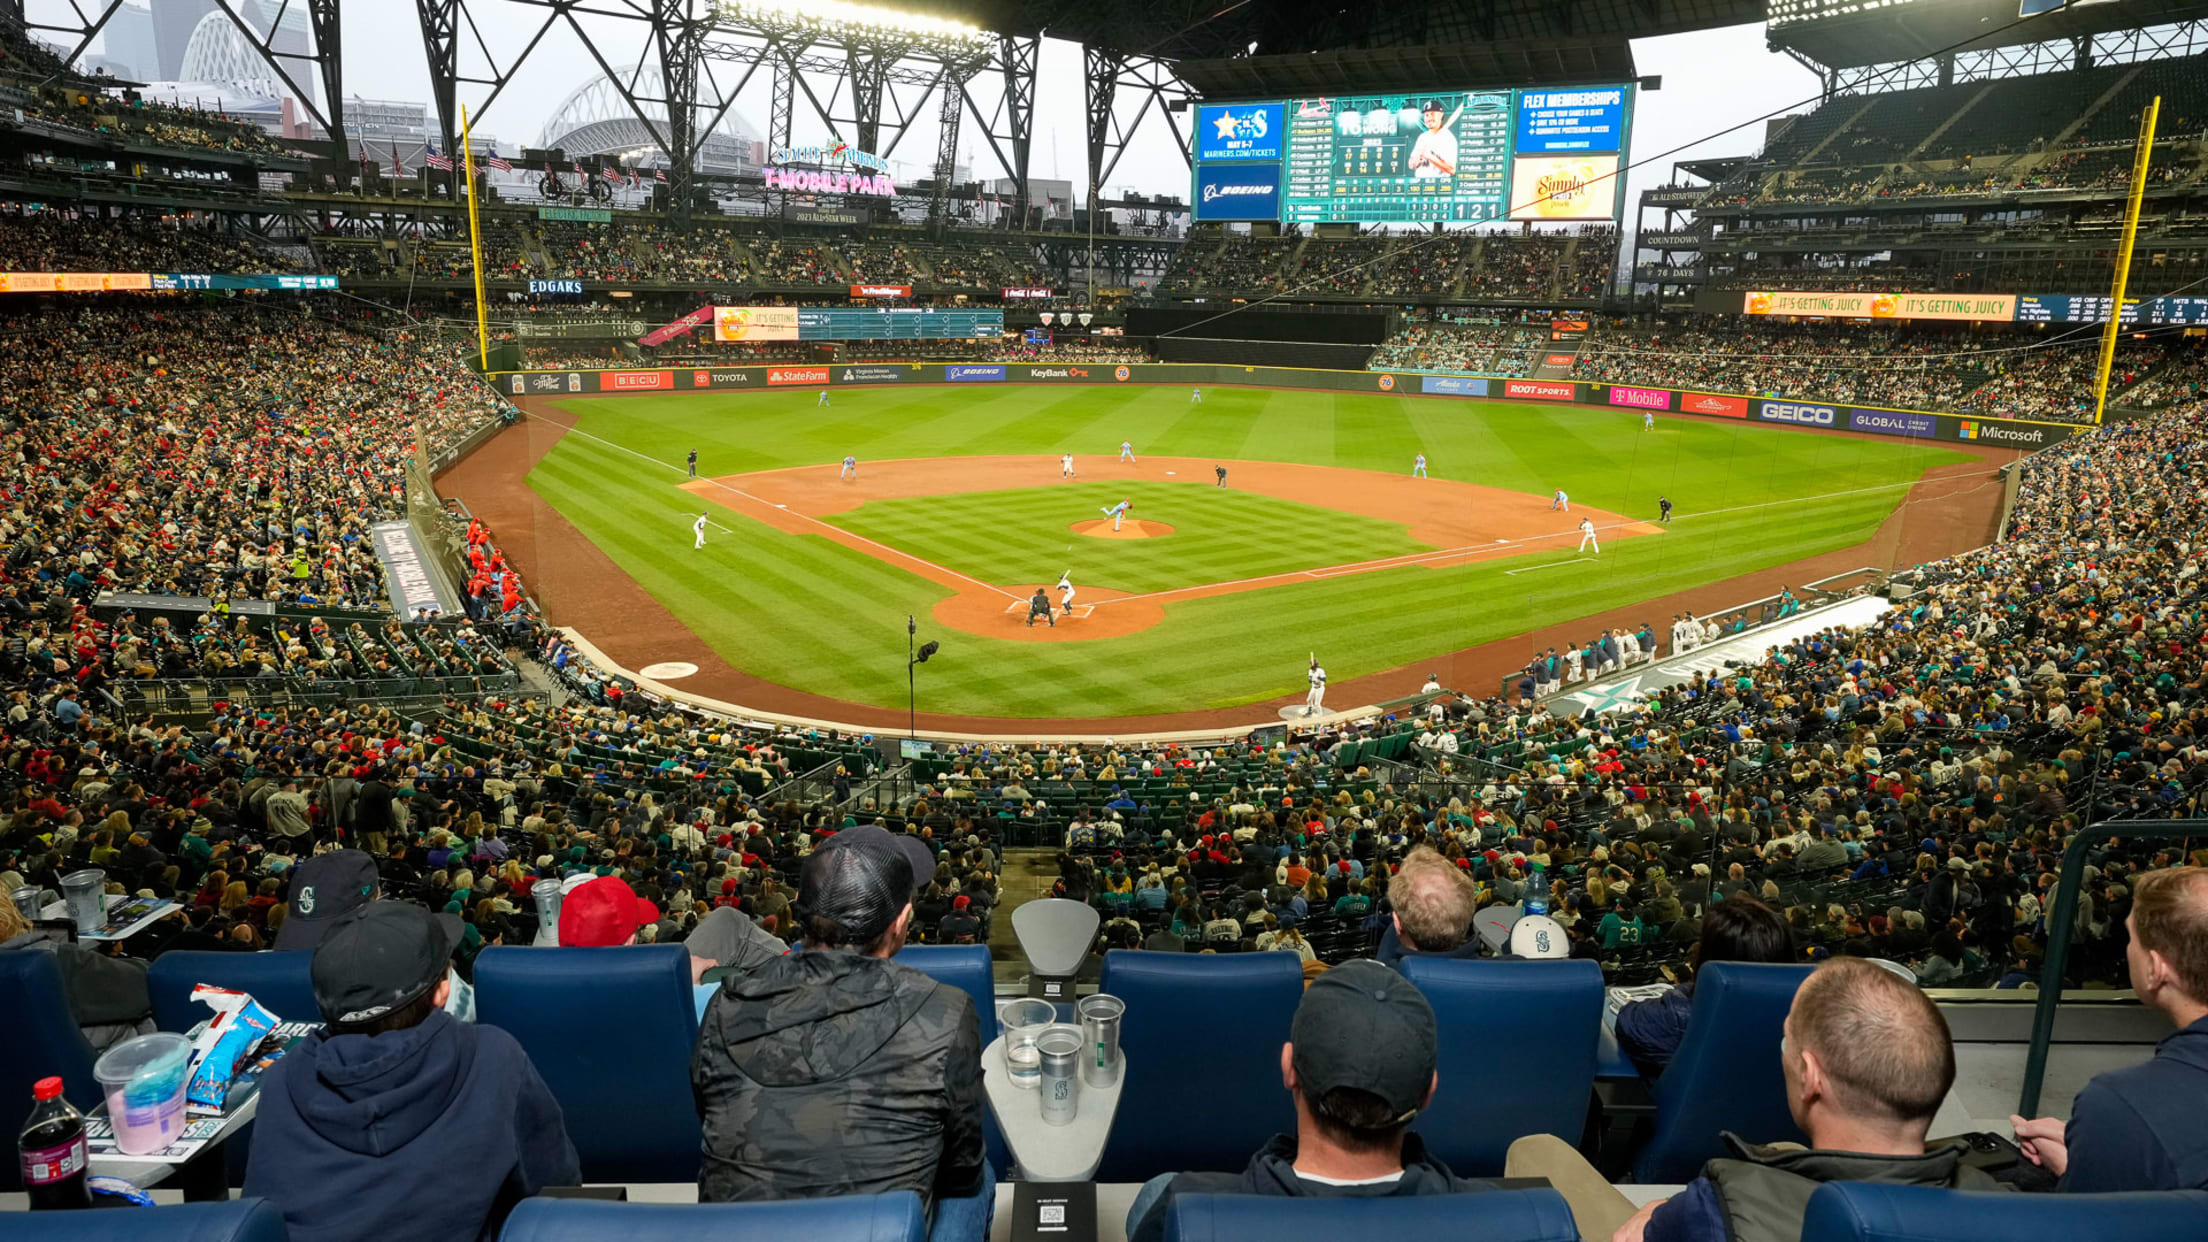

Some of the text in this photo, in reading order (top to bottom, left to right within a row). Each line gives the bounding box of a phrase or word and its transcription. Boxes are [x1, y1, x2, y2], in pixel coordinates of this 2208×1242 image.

[1523, 91, 1621, 109] FLEX MEMBERSHIPS
[1203, 148, 1277, 158] MARINERS.COM/TICKETS
[762, 167, 897, 196] T-MOBILE PARK
[1219, 185, 1275, 195] BOEING
[1456, 203, 1497, 219] 1 2 1
[1647, 236, 1699, 245] COUNTDOWN
[1657, 269, 1695, 277] 76 DAYS
[529, 280, 583, 293] EDGARS
[1779, 297, 1862, 312] IT'S GETTING JUICY
[1906, 299, 2005, 315] IT'S GETTING JUICY
[712, 374, 747, 383] TOYOTA
[1031, 369, 1068, 378] KeyBank
[1117, 368, 1128, 378] 76
[1381, 378, 1393, 387] 76
[1510, 384, 1570, 396] ROOT SPORTS
[1626, 390, 1665, 407] Mobile
[1762, 402, 1834, 424] GEICO
[1856, 415, 1905, 429] GLOBAL
[1981, 426, 2044, 443] Microsoft
[1619, 926, 1639, 943] 23
